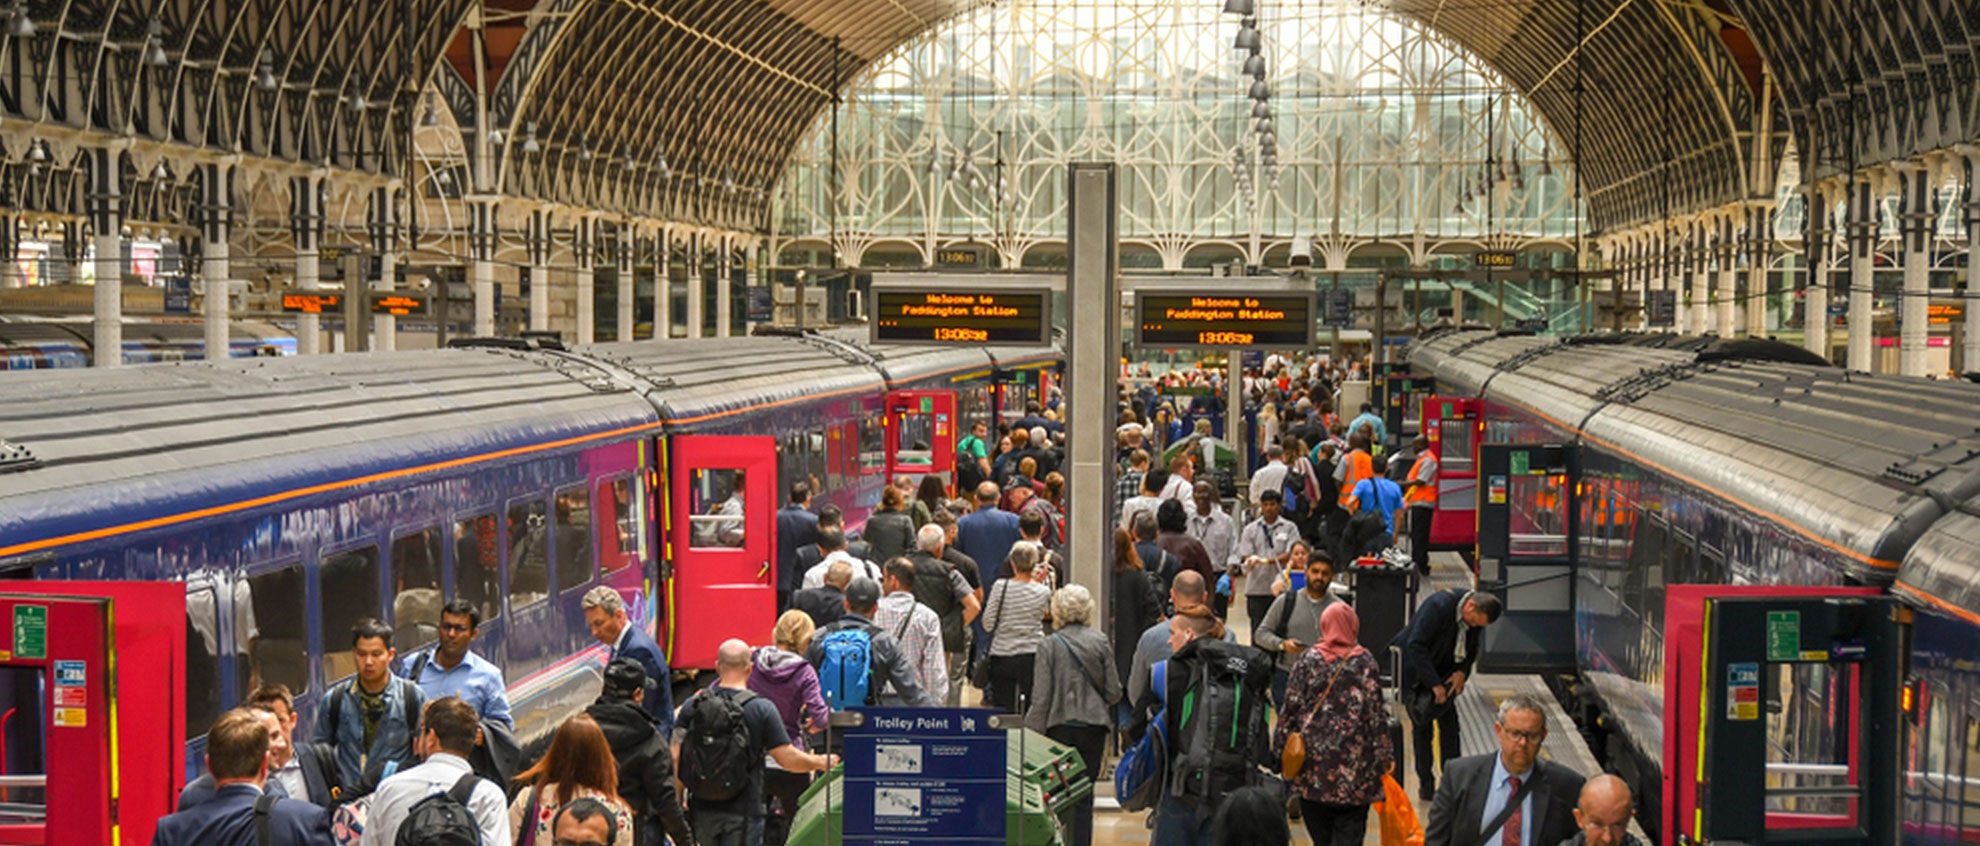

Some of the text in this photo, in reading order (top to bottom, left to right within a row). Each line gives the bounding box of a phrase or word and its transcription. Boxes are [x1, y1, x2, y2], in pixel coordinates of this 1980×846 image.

[926, 294, 993, 304] Welcome to
[1191, 298, 1260, 308] Welcome to
[902, 305, 1019, 317] Paddington Station
[1166, 309, 1285, 321] Paddington Station
[873, 716, 949, 731] Trolley Point
